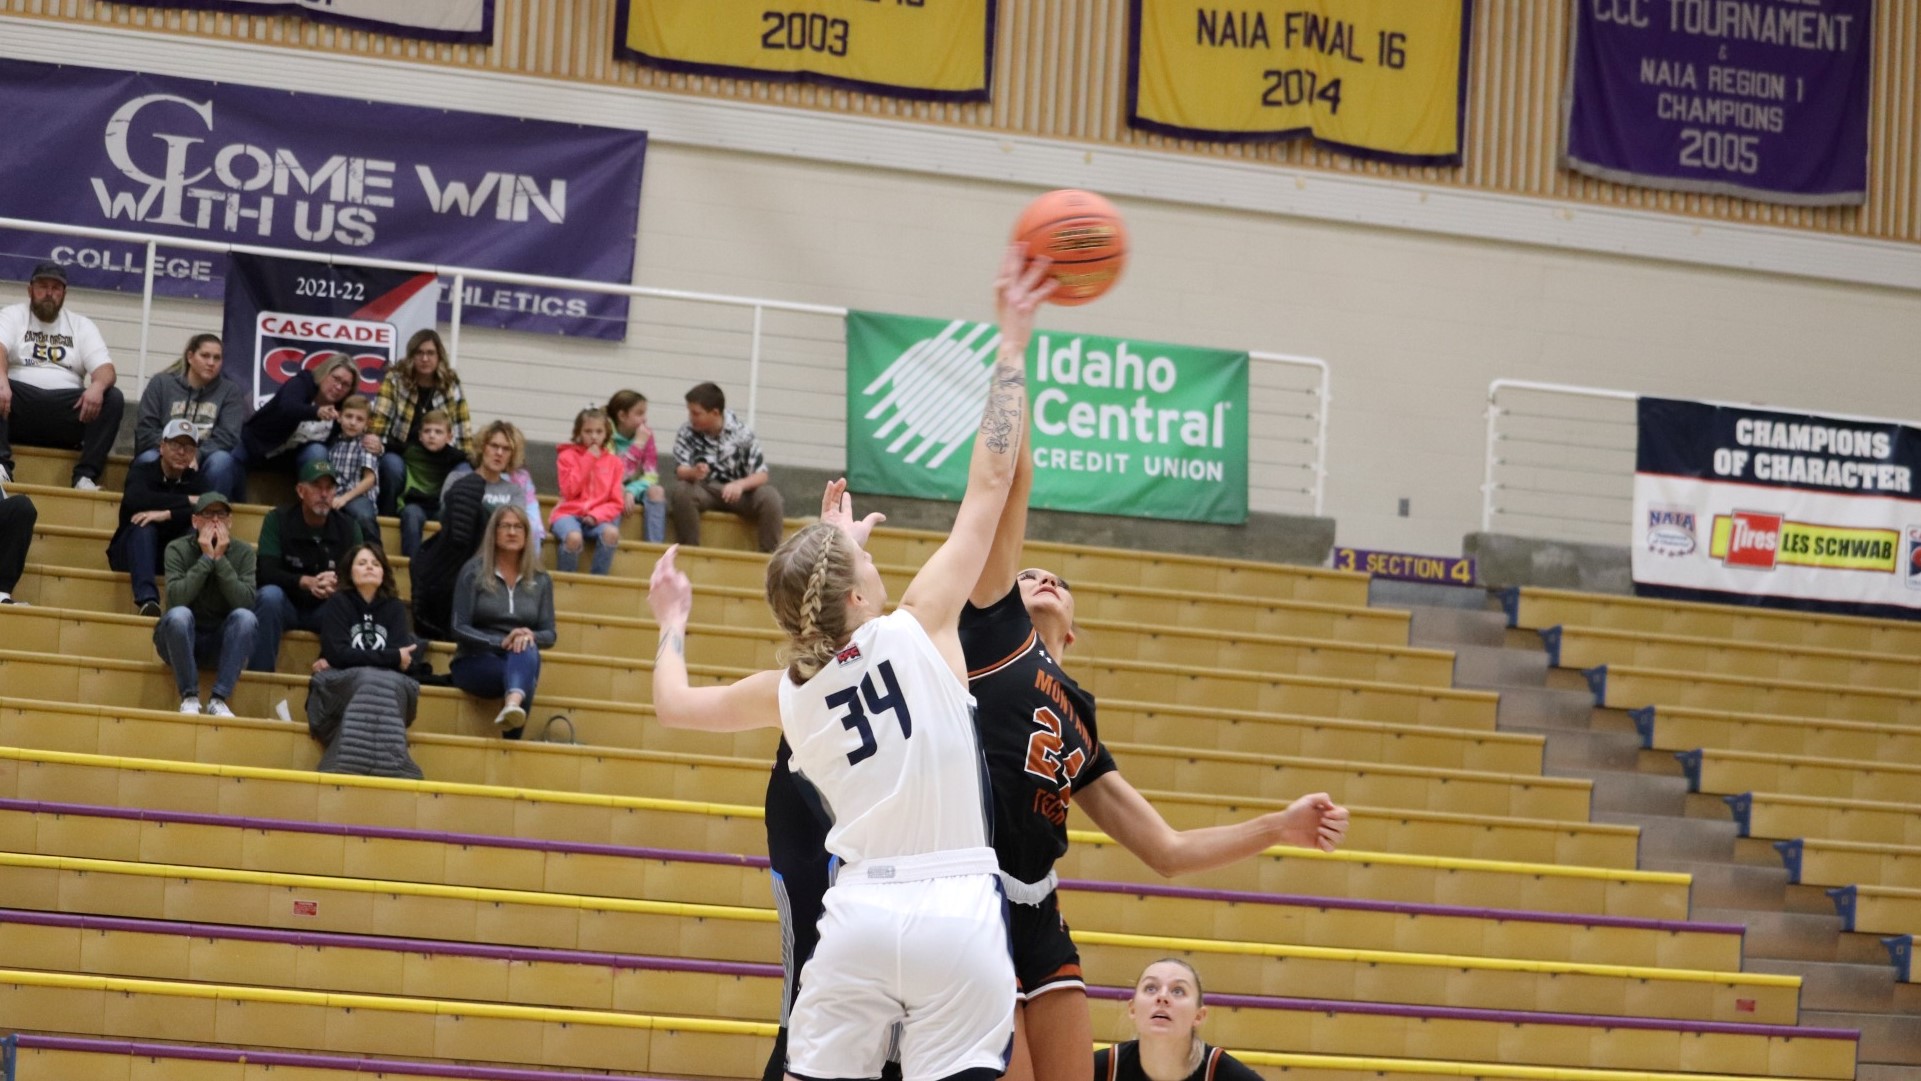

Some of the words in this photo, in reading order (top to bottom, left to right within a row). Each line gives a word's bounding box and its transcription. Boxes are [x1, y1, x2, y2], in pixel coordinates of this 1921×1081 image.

[761, 11, 849, 57] 2003
[1197, 8, 1270, 49] NAIA
[1285, 11, 1364, 63] FINAL
[1378, 30, 1407, 70] 16
[1670, 0, 1853, 51] TOURNAMENT
[1261, 69, 1342, 115] 2014
[1640, 57, 1697, 91] NAIA
[1708, 65, 1785, 100] REGION
[1657, 93, 1784, 134] CHAMPIONS
[105, 93, 397, 208] COME
[414, 164, 567, 224] WIN
[1679, 129, 1760, 174] 2005
[90, 133, 275, 237] WITH
[293, 200, 378, 247] US
[51, 246, 213, 282] COLLEGE
[295, 276, 366, 302] 2021-22
[438, 282, 589, 318] THLETICS
[261, 316, 391, 344] CASCADE
[1037, 335, 1177, 394] Idaho
[1033, 387, 1225, 448] Central
[1736, 417, 1892, 460] CHAMPIONS
[1033, 447, 1130, 474] CREDIT
[1144, 456, 1224, 482] UNION
[1713, 447, 1749, 477] OF
[1754, 453, 1912, 493] CHARACTER
[1732, 518, 1777, 553] Tires
[1782, 532, 1810, 554] LES
[1813, 536, 1893, 560] SCHWAB
[1338, 548, 1356, 572] 3
[1366, 552, 1446, 579] SECTION
[1450, 560, 1471, 583] 4
[824, 659, 913, 767] 34
